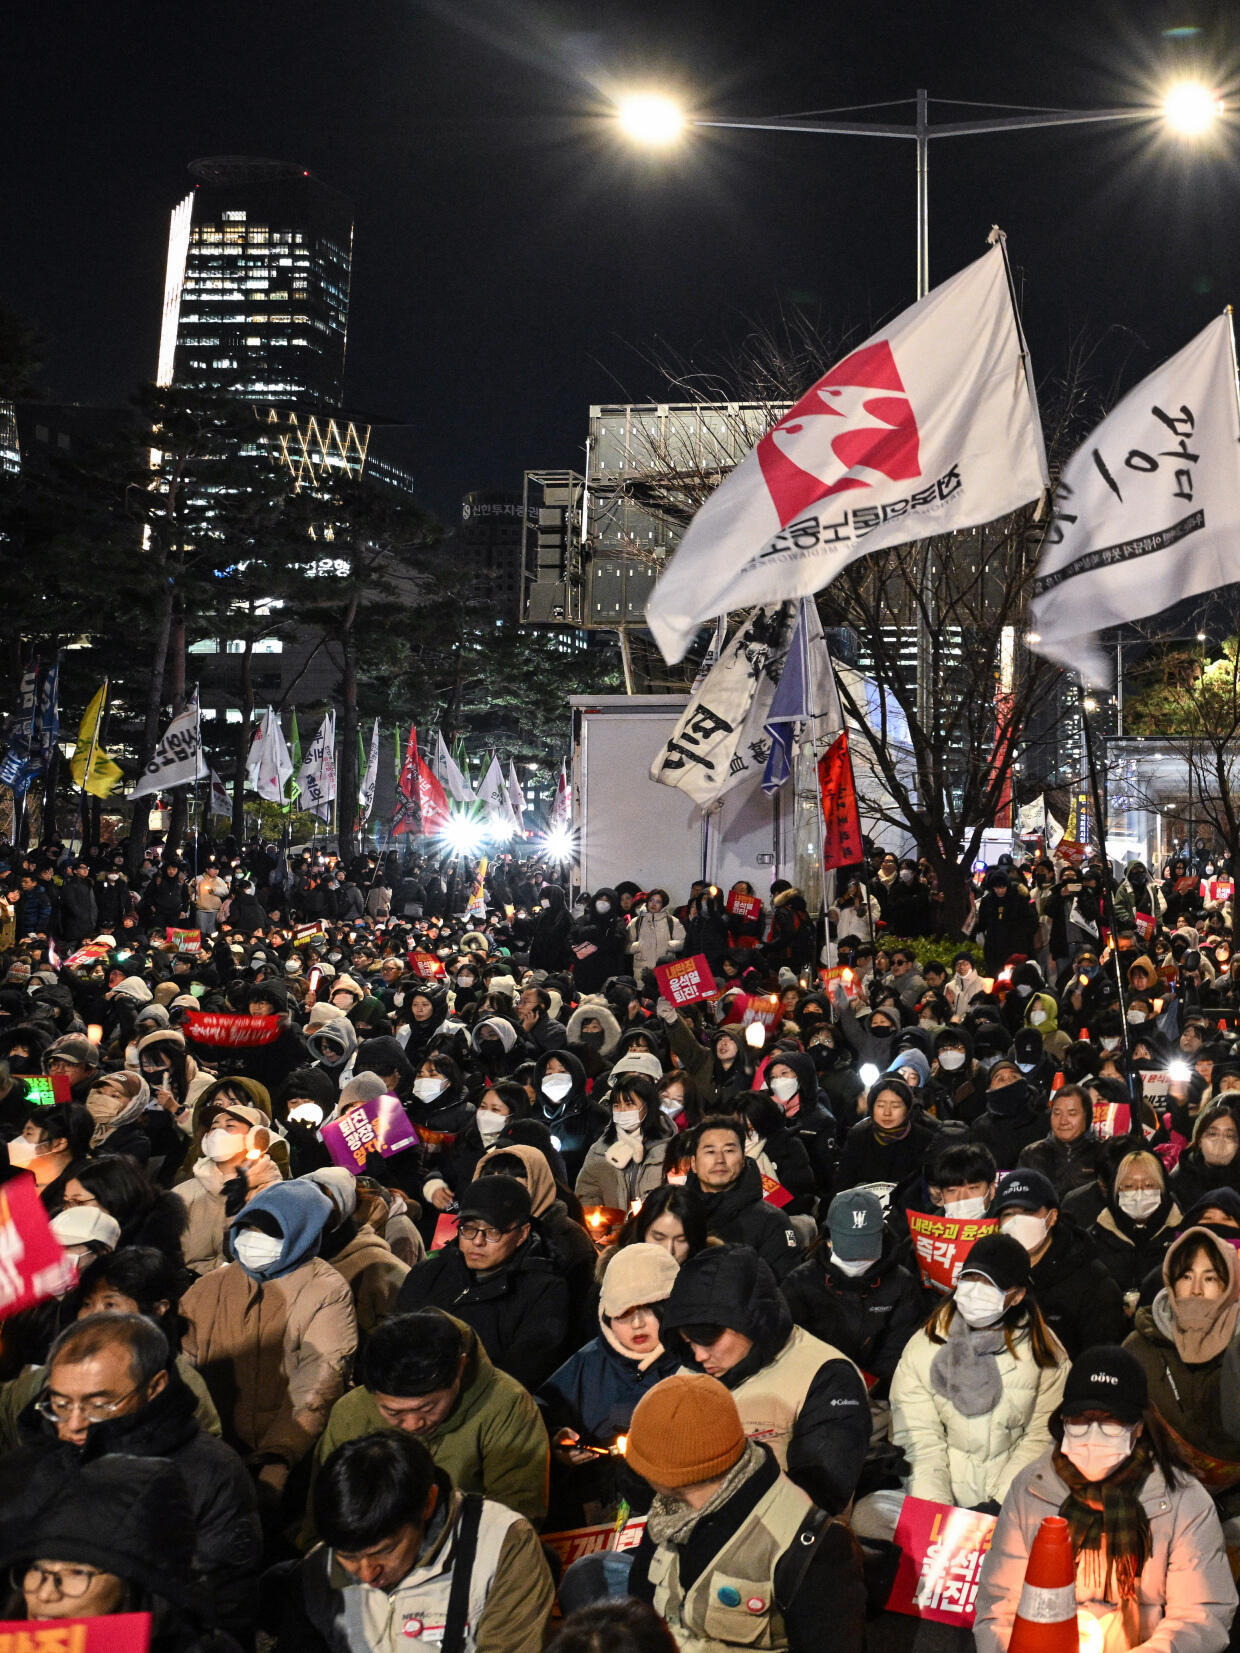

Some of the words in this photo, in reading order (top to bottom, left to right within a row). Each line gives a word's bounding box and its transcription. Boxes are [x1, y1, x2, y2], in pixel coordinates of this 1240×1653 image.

[665, 958, 697, 980] 내란죄
[669, 970, 701, 992] 윤석열
[673, 985, 700, 1004] 퇴진!
[911, 1216, 960, 1241] 내란수괴
[916, 1235, 957, 1269] 즉각
[1090, 1372, 1119, 1386] oöve
